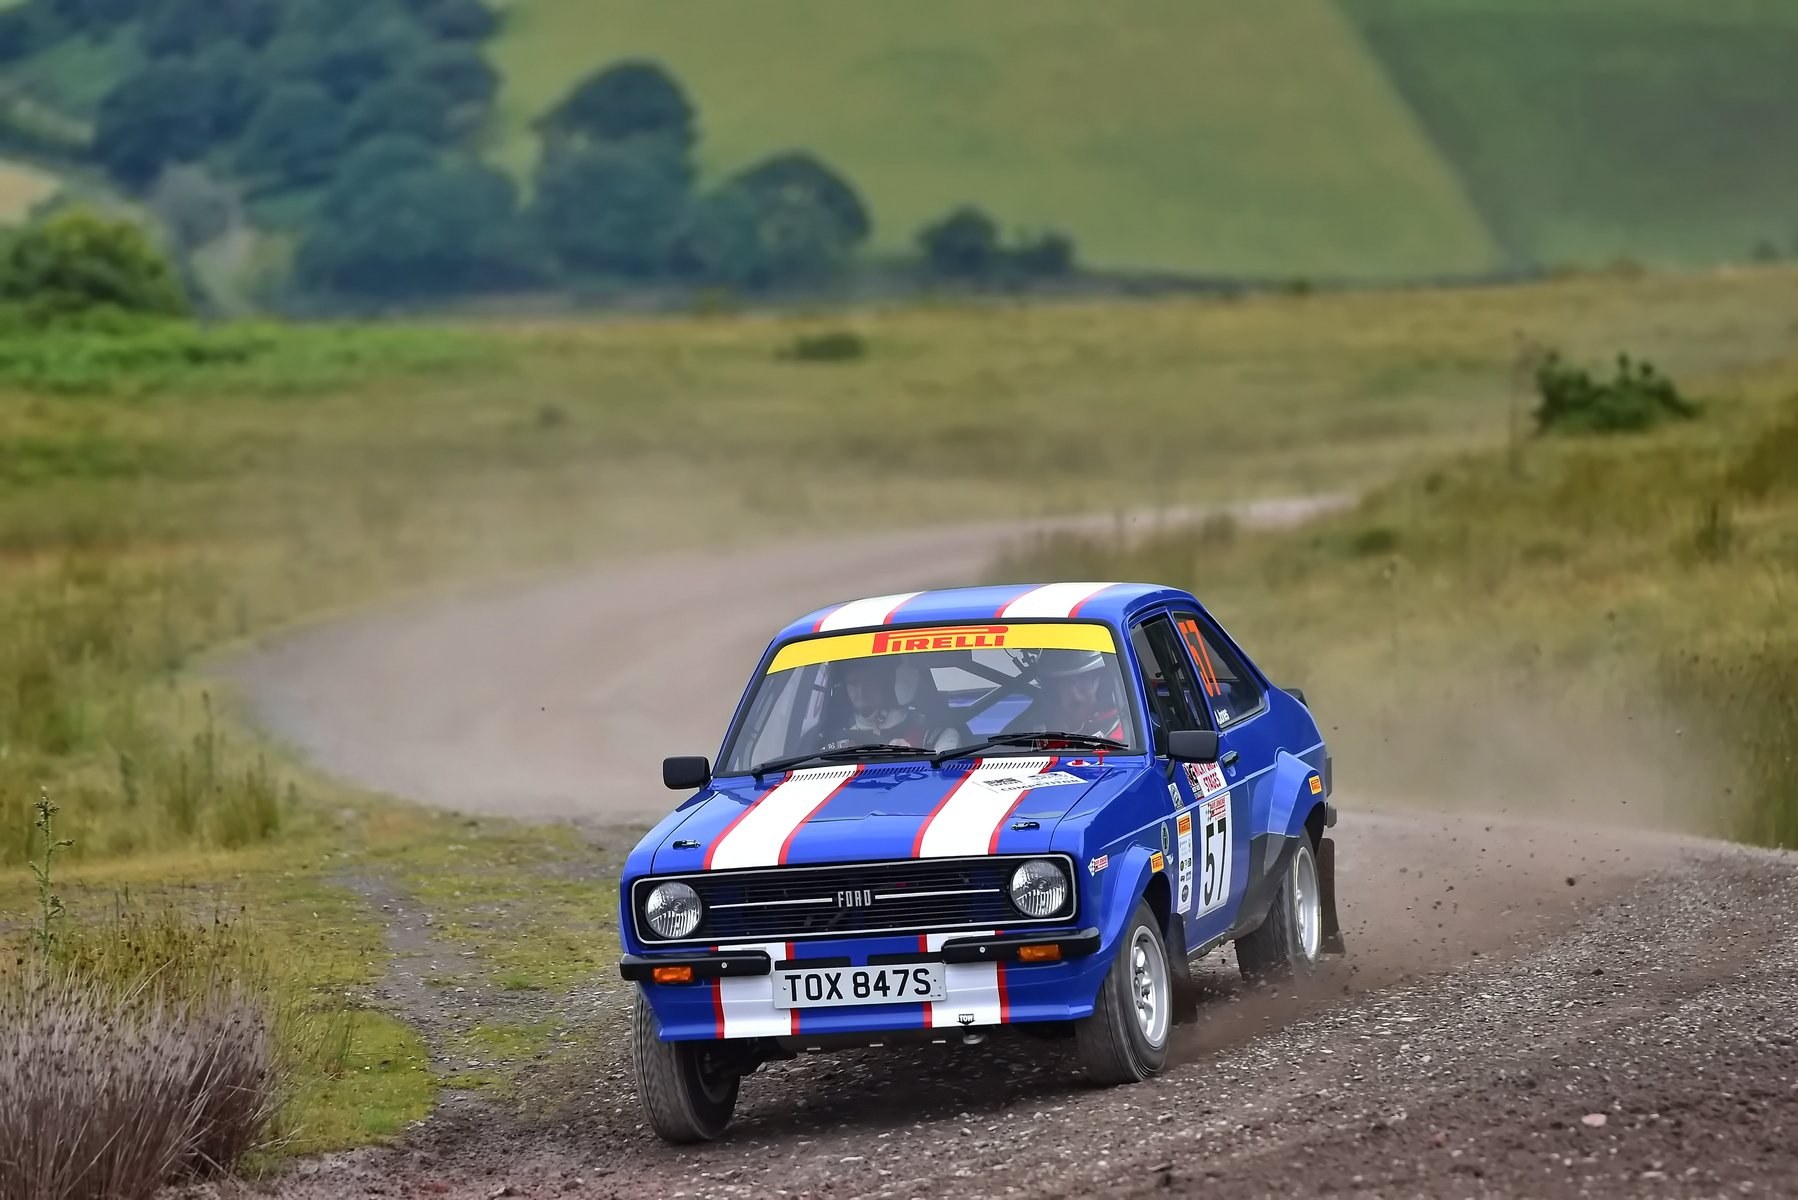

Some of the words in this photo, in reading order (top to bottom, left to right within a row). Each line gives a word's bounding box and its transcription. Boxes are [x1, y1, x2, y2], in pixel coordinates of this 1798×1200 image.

[872, 626, 1009, 654] PIRELLI
[1178, 620, 1221, 697] 57
[1204, 816, 1227, 906] 57
[837, 889, 871, 908] FORD
[785, 973, 843, 1001] TOX
[852, 968, 931, 998] 847S
[959, 1014, 974, 1023] TOW
